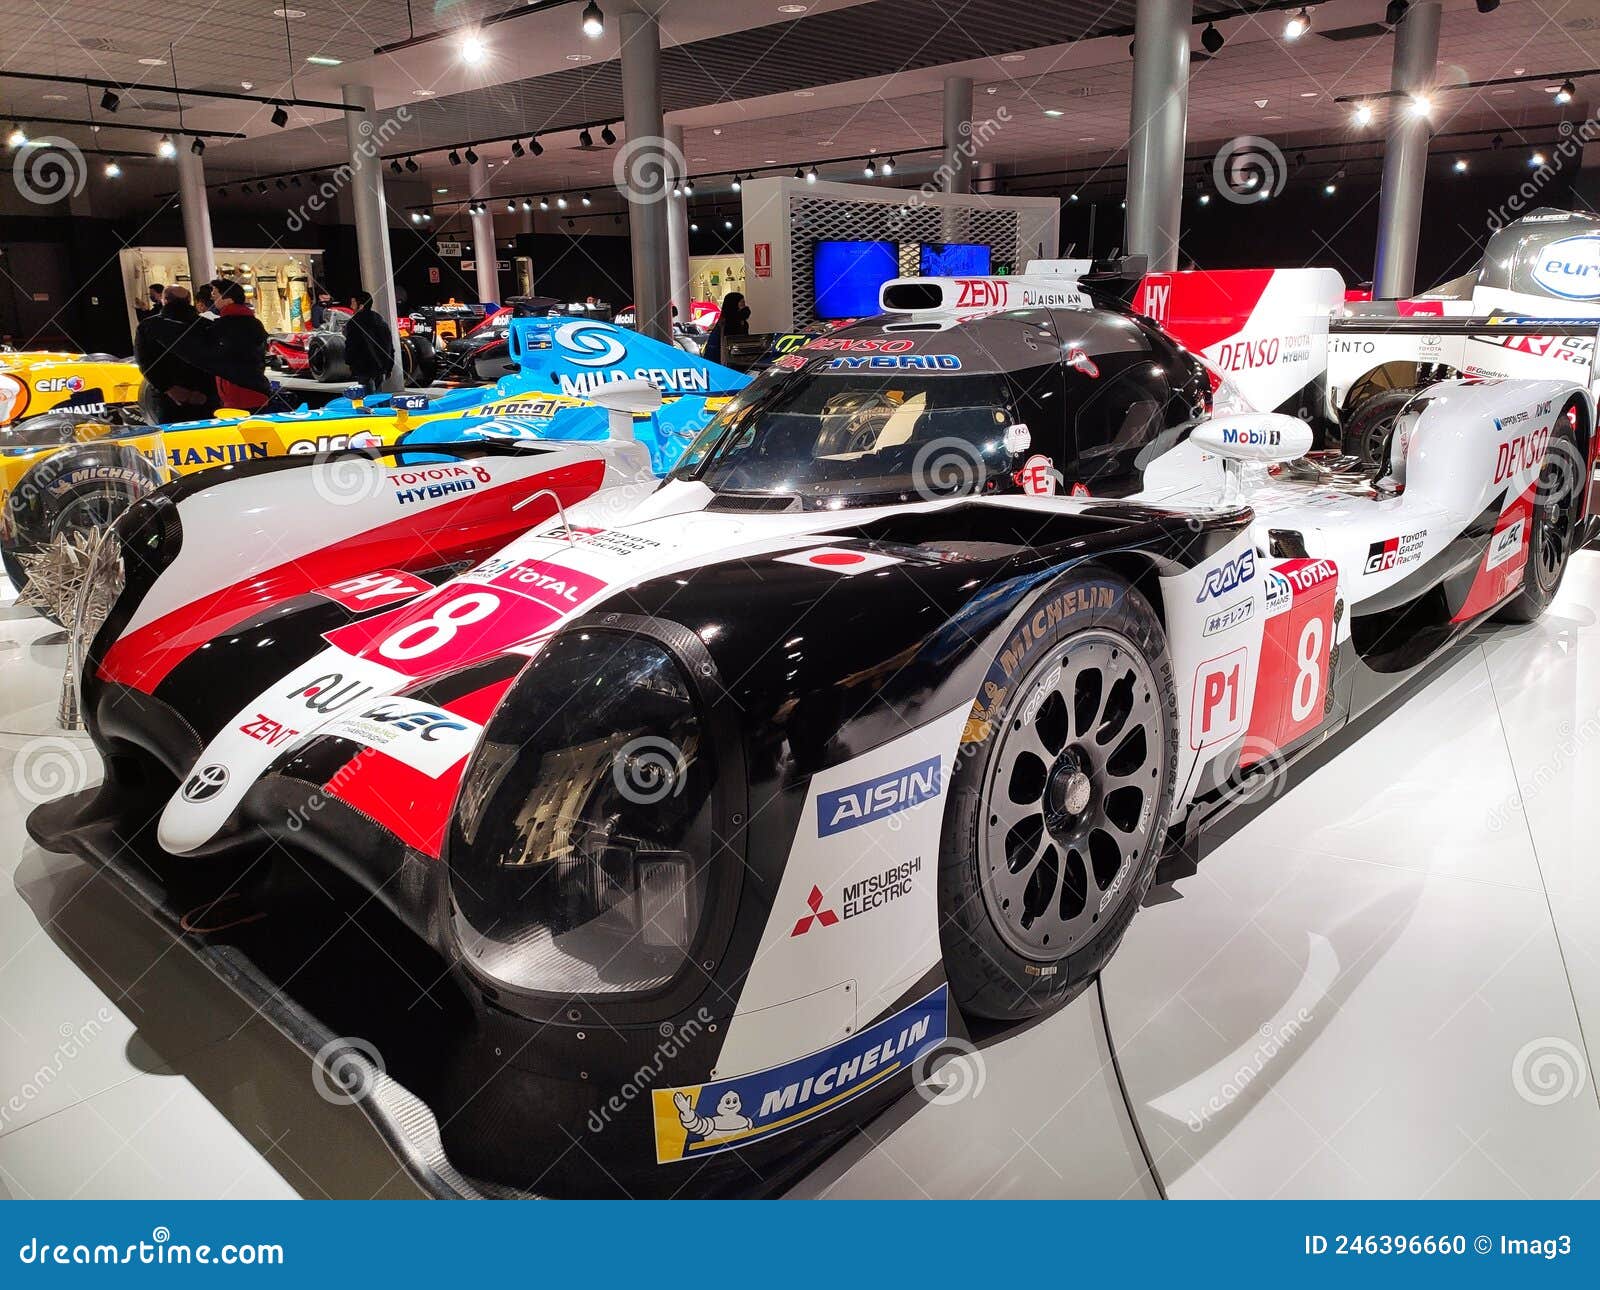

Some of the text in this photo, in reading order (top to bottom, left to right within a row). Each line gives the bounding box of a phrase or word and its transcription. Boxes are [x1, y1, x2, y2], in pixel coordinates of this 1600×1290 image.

[1545, 259, 1600, 277] eur
[955, 281, 1009, 307] ZENT
[1038, 294, 1065, 305] AISIN
[1067, 294, 1082, 304] AW
[1145, 284, 1169, 321] HY
[1219, 337, 1280, 371] DENSO
[1284, 335, 1311, 347] TOYOTA
[818, 354, 963, 370] HYBRID
[36, 380, 66, 392] elf
[634, 367, 710, 390] SEVEN
[406, 399, 424, 408] elf
[288, 435, 350, 456] elf
[1223, 428, 1267, 445] Mobil
[1494, 426, 1548, 484] DENSO
[387, 466, 491, 486] TOYOTA 8
[396, 478, 476, 504] HYBRID
[585, 538, 632, 555] Racing
[607, 530, 661, 548] TOYOTA
[1399, 540, 1424, 555] GAZOO
[1401, 529, 1428, 545] TOYOTA
[1366, 550, 1398, 573] GR
[1397, 552, 1422, 567] Racing
[331, 572, 420, 600] HY
[509, 566, 579, 602] TOTAL
[1196, 549, 1256, 603] RAYS
[1291, 560, 1337, 592] TOTAL
[379, 592, 500, 660] 8
[999, 586, 1115, 678] MICHELIN
[1292, 618, 1324, 722] 8
[1202, 663, 1240, 733] P1
[238, 714, 300, 748] ZENT
[829, 766, 935, 826] AISIN
[843, 856, 921, 903] MITSUBISHI
[843, 877, 912, 920] ELECTRIC
[758, 1015, 931, 1118] MICHELIN
